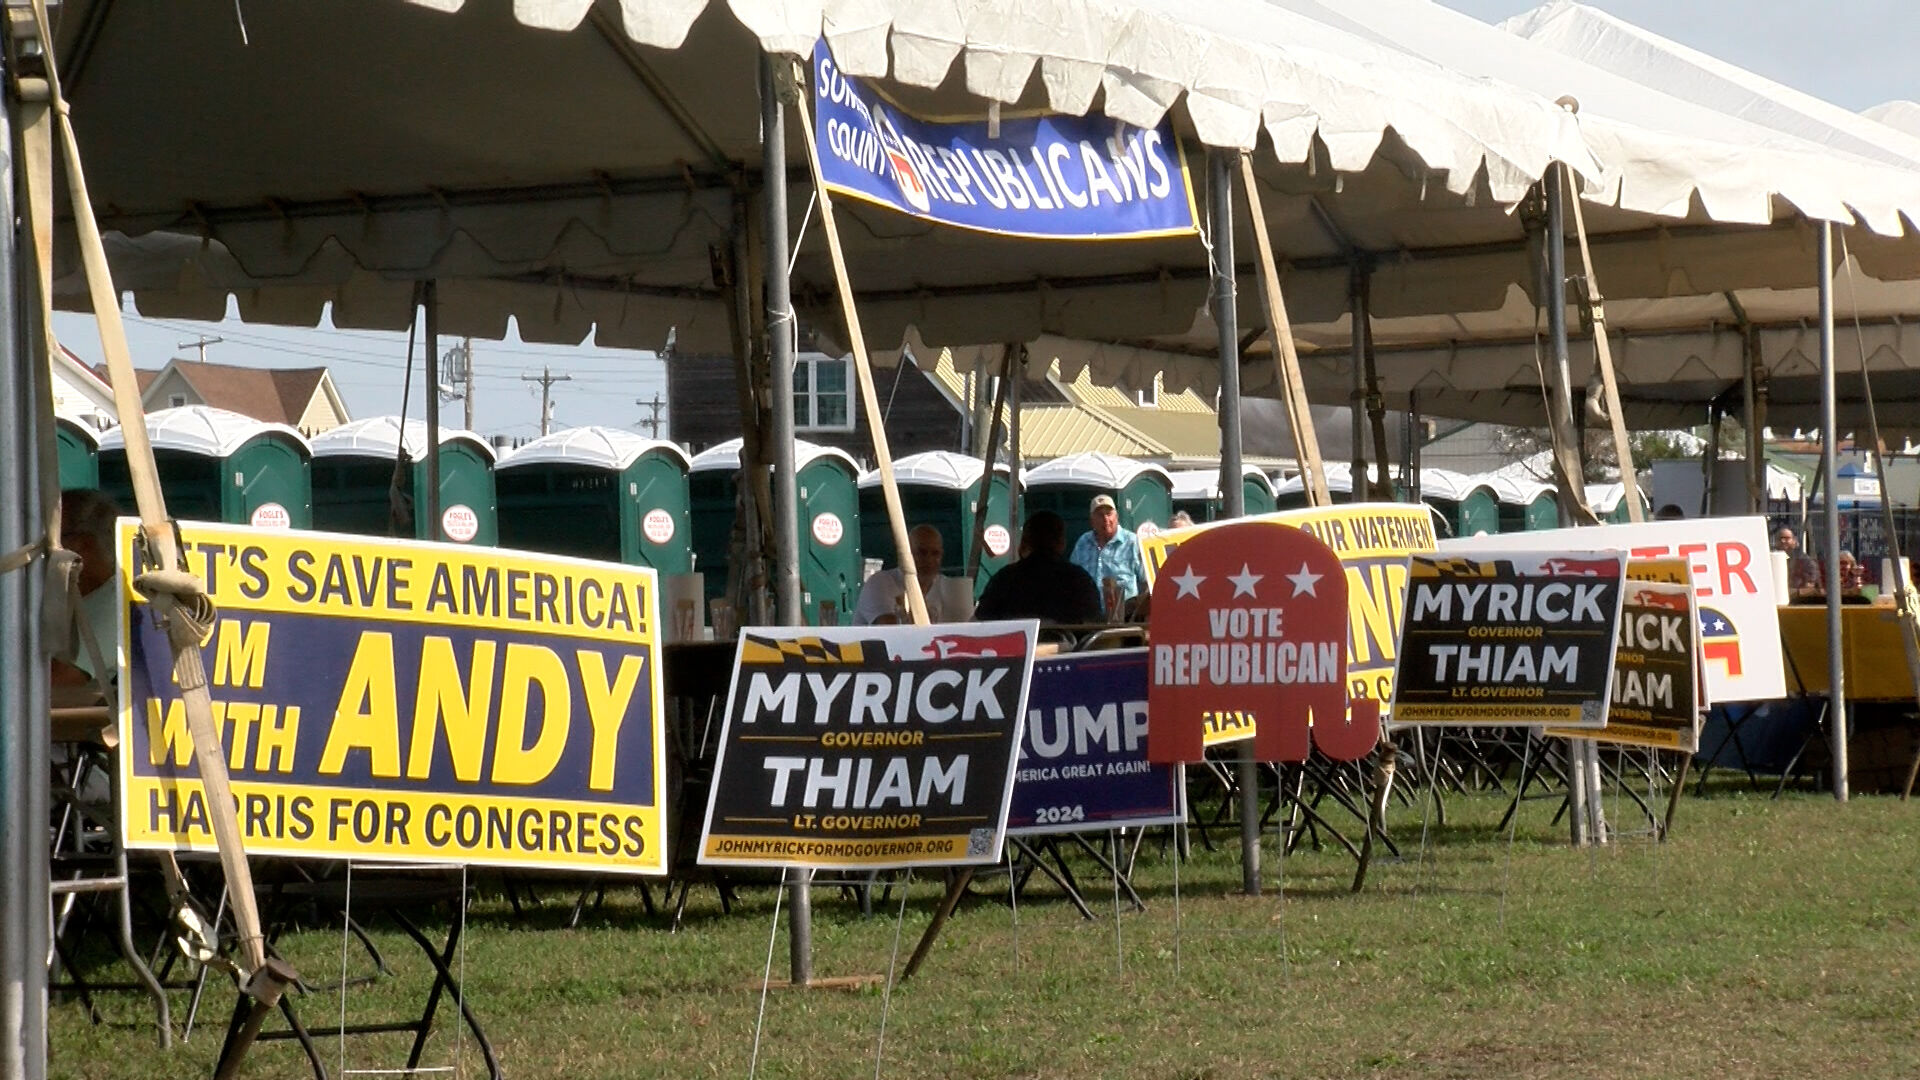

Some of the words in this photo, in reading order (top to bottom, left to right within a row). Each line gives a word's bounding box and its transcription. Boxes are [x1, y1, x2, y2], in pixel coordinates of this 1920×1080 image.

[902, 130, 1170, 210] REPUBLICANS
[287, 550, 413, 611] SAVE
[426, 562, 647, 633] AMERICA!
[1412, 583, 1608, 623] MYRICK
[1208, 608, 1284, 638] VOTE
[1468, 626, 1543, 638] GOVERNOR
[1154, 642, 1338, 686] REPUBLICAN
[1428, 645, 1580, 684] THIAM
[741, 667, 1009, 725] MYRICK
[1451, 686, 1469, 698] LT.
[1470, 686, 1544, 698] GOVERNOR
[1612, 669, 1673, 709] IAM
[318, 630, 645, 792] ANDY
[1018, 701, 1149, 760] UMP
[821, 730, 924, 748] GOVERNOR
[763, 754, 970, 808] THIAM
[1015, 767, 1060, 783] MERICA
[1061, 763, 1104, 780] GREAT
[1106, 761, 1151, 776] AGAIN!
[149, 788, 315, 841] HARIS
[329, 799, 411, 845] FOR
[424, 804, 645, 857] CONGRESS
[793, 814, 817, 830] LT.
[821, 814, 921, 830] GOVERNOR
[1035, 804, 1085, 823] 2024
[715, 840, 954, 857] JOHNMYRICKFORMDGOVERNOR.ORG
